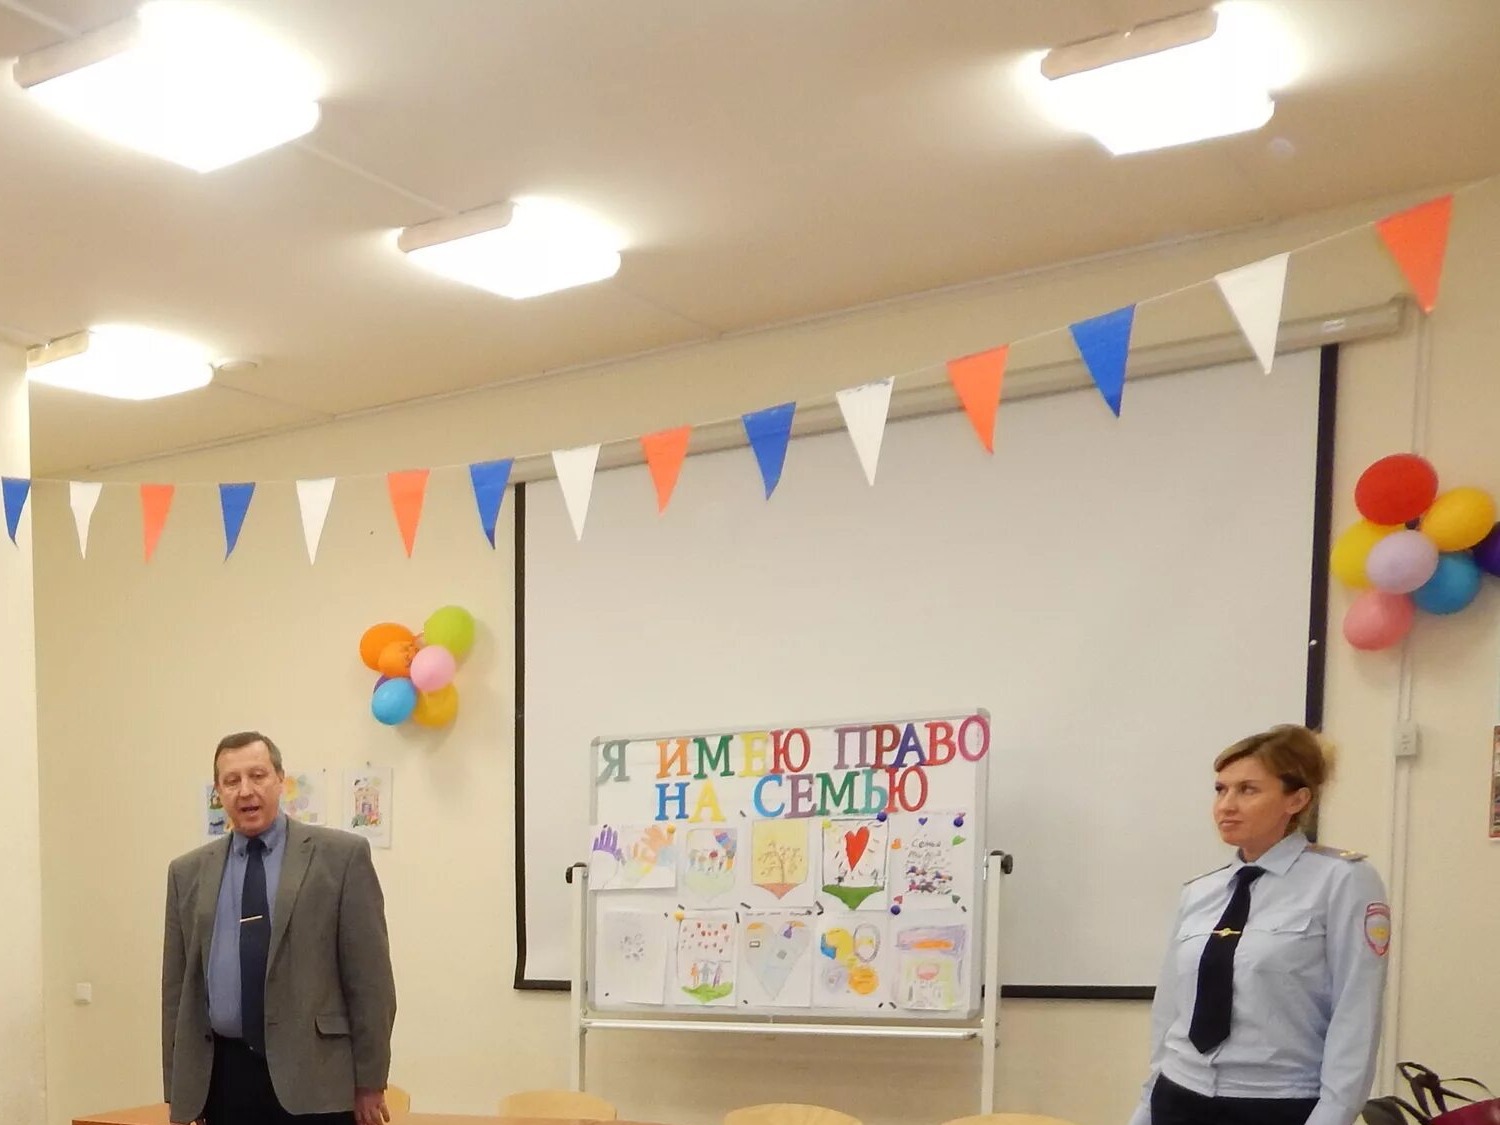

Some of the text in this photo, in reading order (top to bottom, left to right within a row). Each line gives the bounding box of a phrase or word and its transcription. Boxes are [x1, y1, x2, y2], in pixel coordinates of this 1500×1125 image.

[595, 714, 990, 785] Я ИМЕЮ ПРАВО
[655, 765, 928, 823] НА СЕМЬЮ
